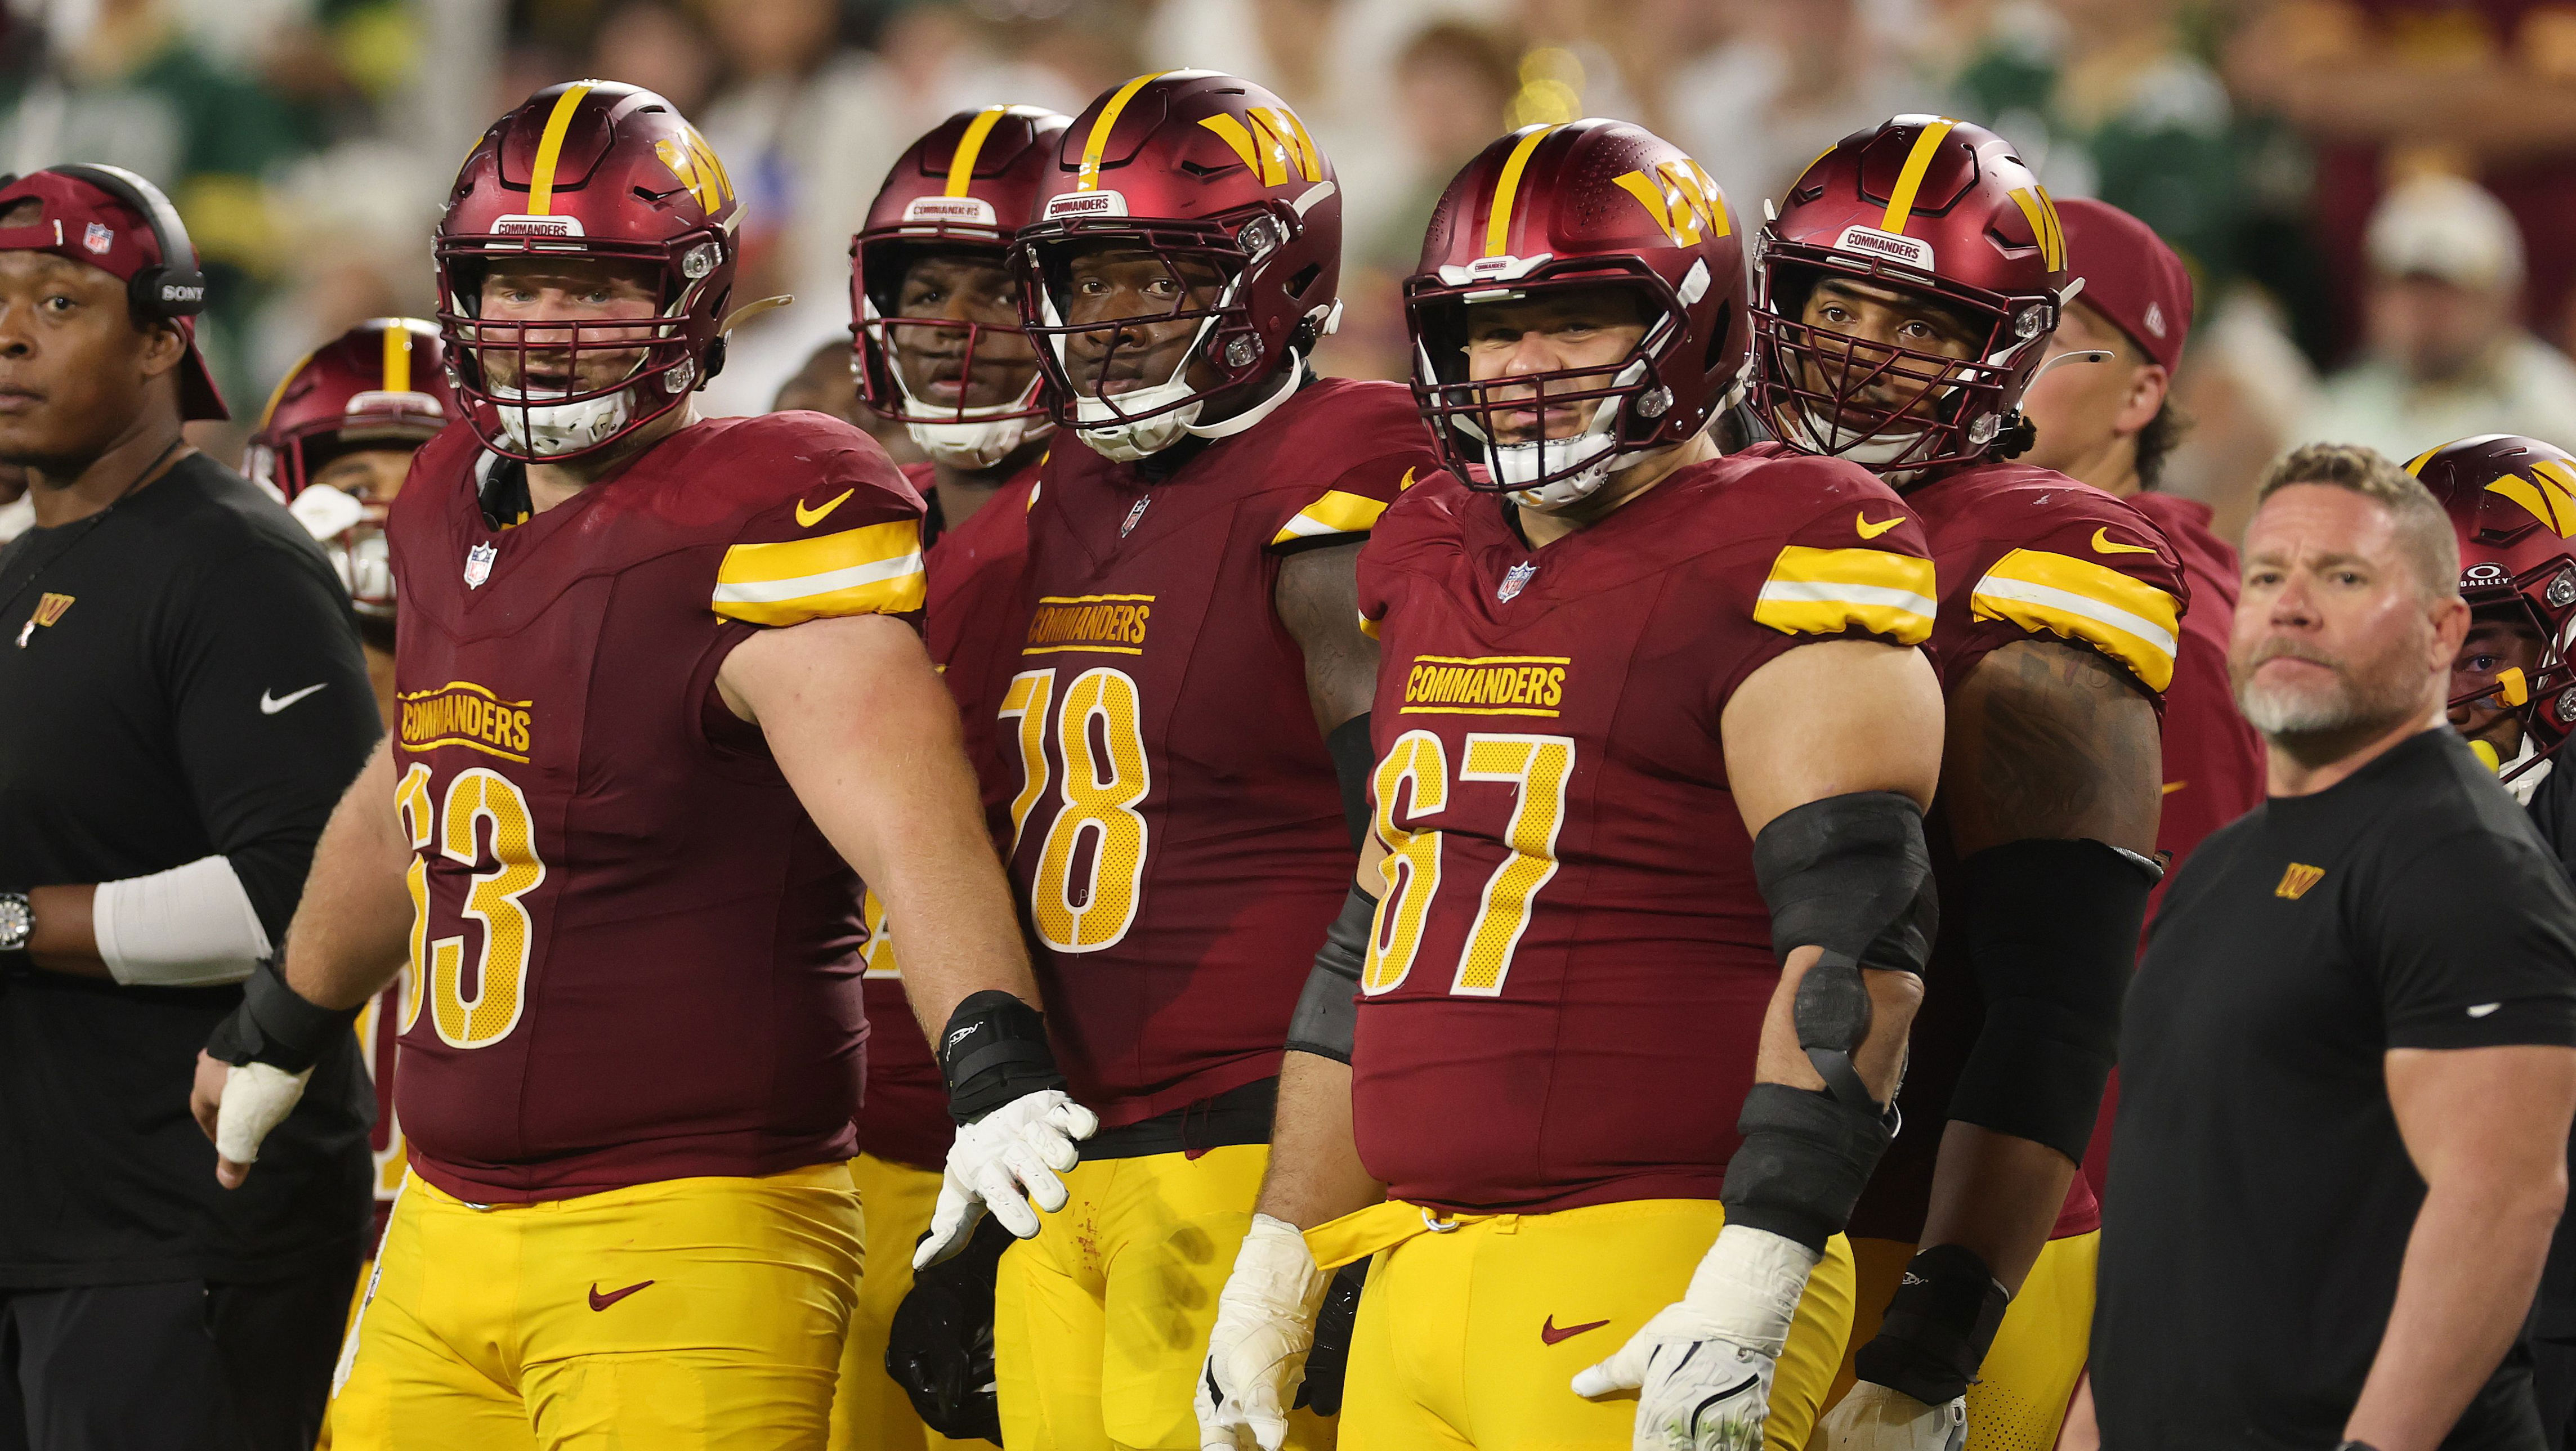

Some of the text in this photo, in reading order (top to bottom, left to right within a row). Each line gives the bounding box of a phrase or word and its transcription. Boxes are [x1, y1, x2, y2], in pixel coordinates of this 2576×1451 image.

[914, 206, 978, 216] COMMANDERS
[1049, 198, 1108, 214] COMMANDERS
[499, 223, 567, 236] COMMANDERS
[1847, 232, 1920, 259] COMMANDERS
[162, 285, 204, 301] SONY
[2460, 577, 2508, 587] OAKLEY
[1027, 605, 1150, 644] COMMANDERS
[1405, 665, 1566, 706] COMMANDERS
[401, 694, 531, 751] COMMANDERS
[998, 667, 1151, 953] 78
[1361, 729, 1576, 997] 67
